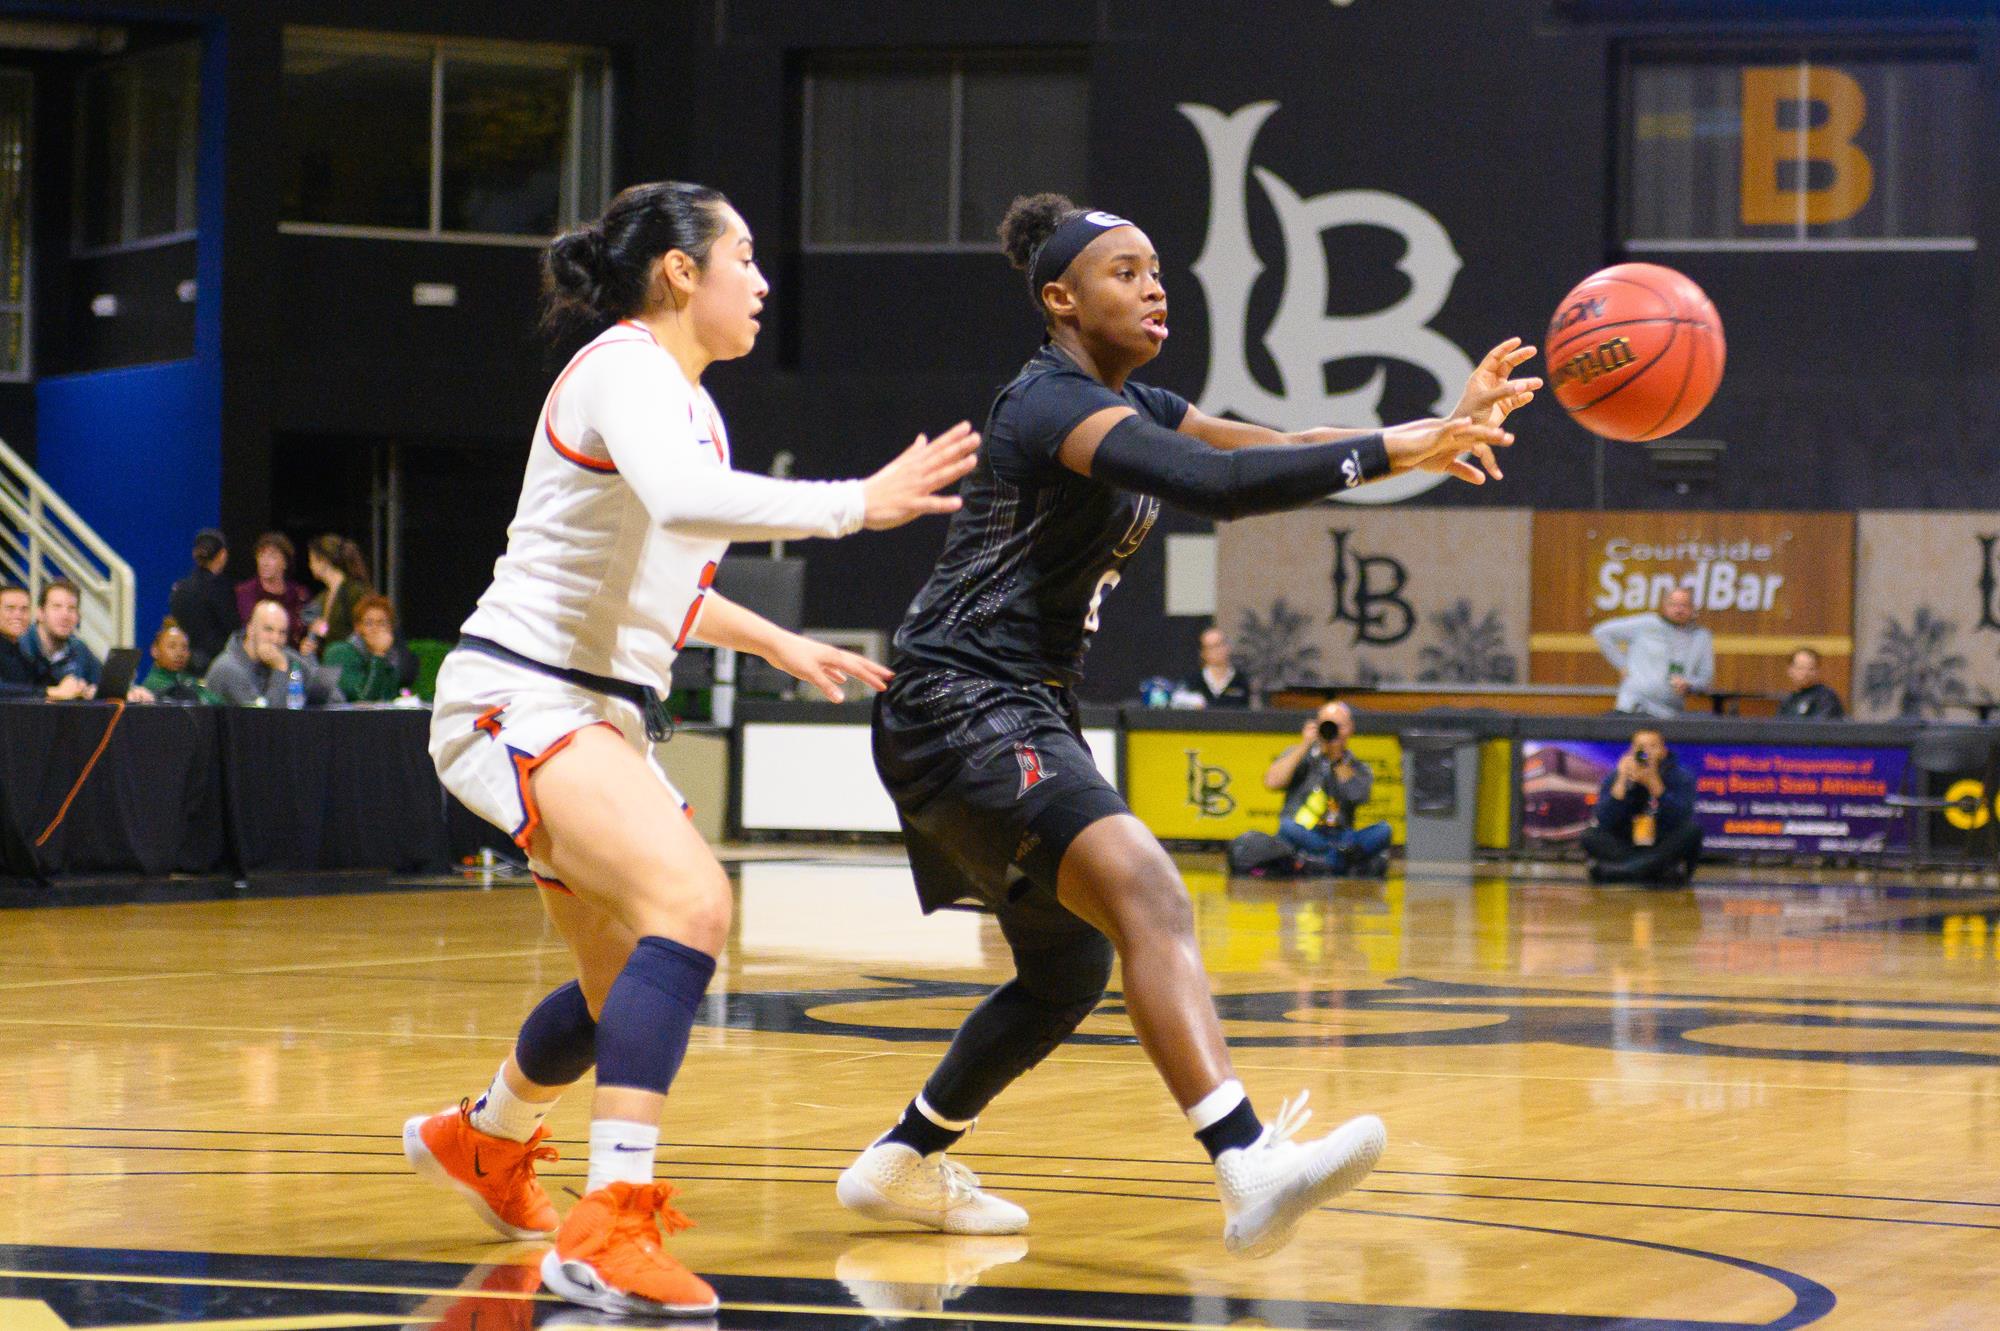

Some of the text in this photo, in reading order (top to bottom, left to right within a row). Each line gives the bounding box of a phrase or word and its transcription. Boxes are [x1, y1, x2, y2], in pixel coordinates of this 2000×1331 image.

[1741, 66, 1873, 225] B
[1606, 538, 1772, 561] Courtside
[1327, 527, 1416, 648] LB
[1596, 560, 1783, 612] SandBar
[1184, 748, 1237, 821] LB
[1728, 774, 1776, 793] Beach
